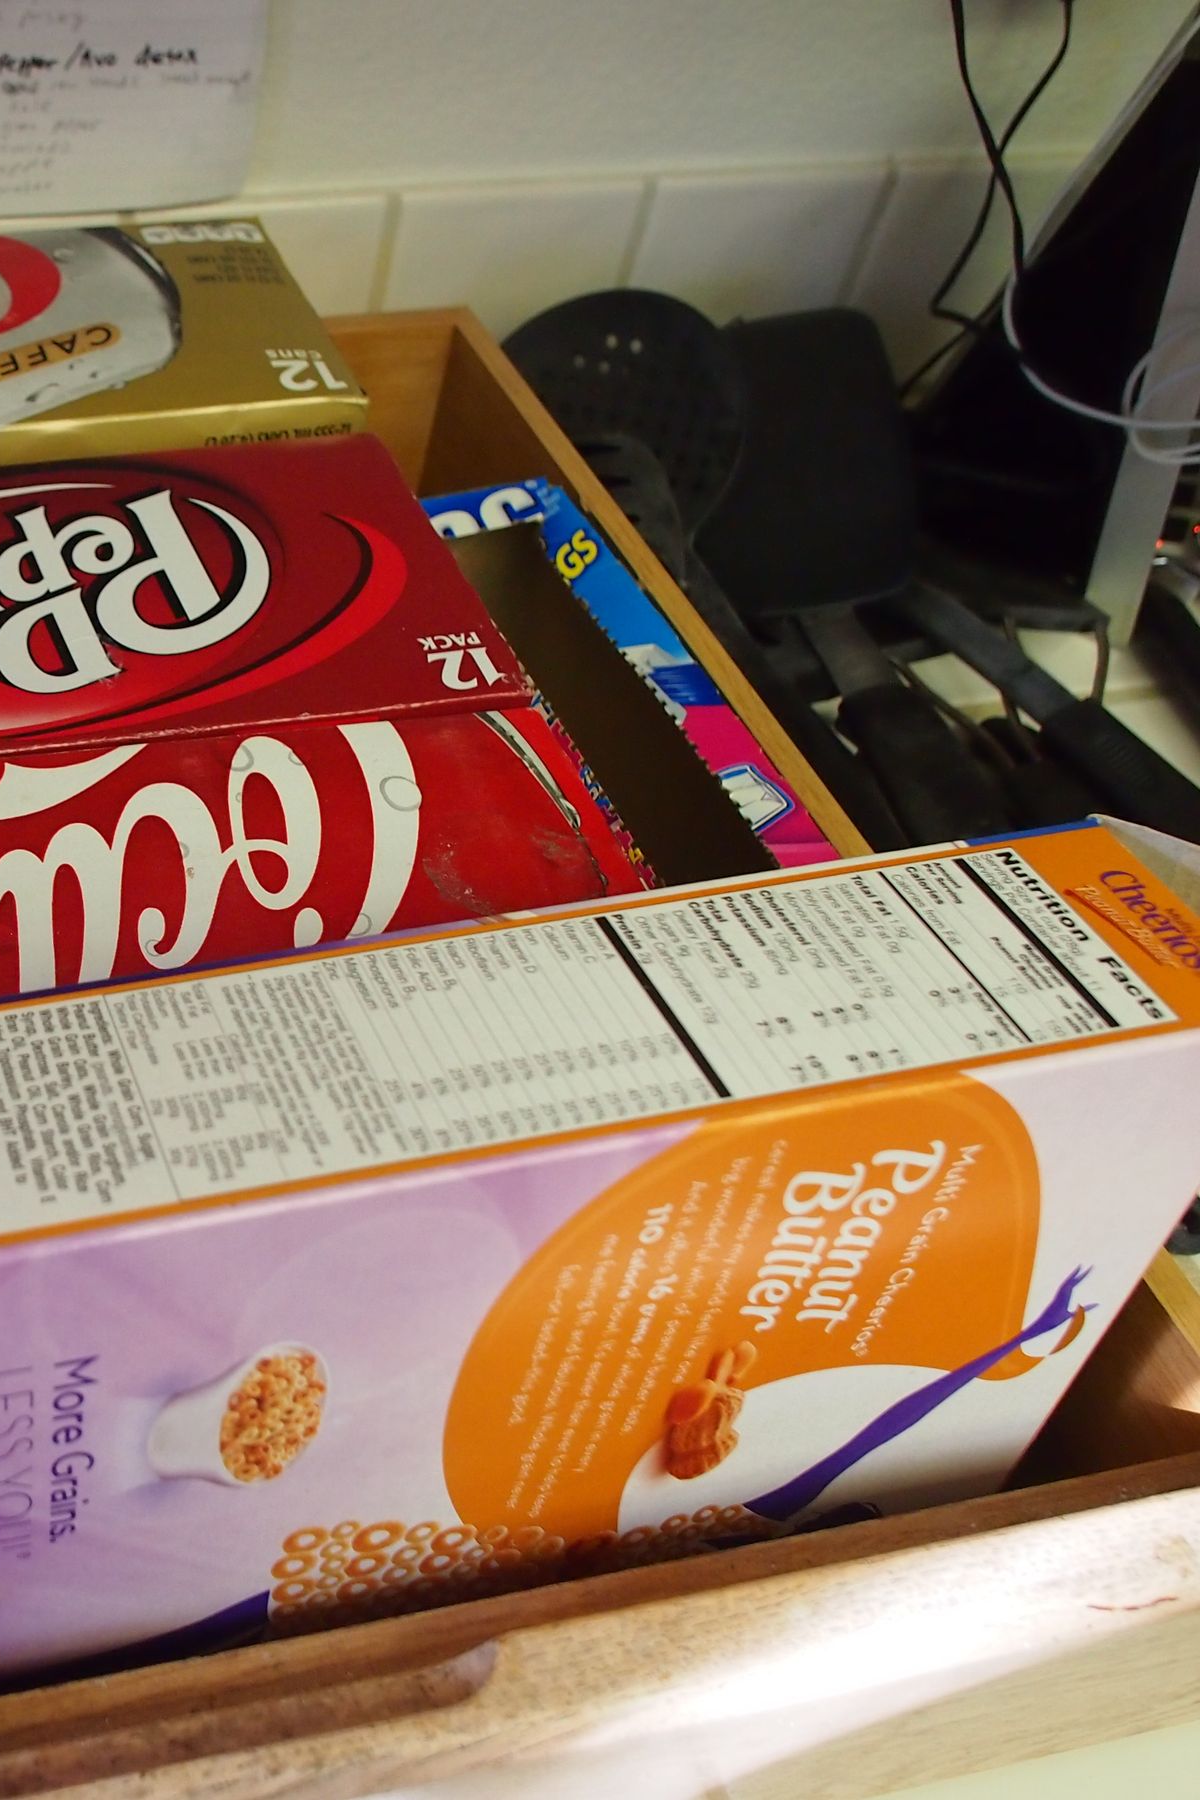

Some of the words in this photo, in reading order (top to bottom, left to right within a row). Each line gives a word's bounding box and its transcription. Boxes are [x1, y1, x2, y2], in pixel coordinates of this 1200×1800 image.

[269, 359, 349, 391] 12
[417, 630, 487, 652] PACK
[425, 645, 508, 691] 12
[849, 875, 876, 899] Total
[871, 900, 893, 917] Fat
[890, 874, 928, 907] Calories
[904, 866, 946, 904] Calories
[932, 862, 961, 888] Amount
[933, 877, 963, 904] Serving
[979, 854, 1015, 883] Serving
[1010, 885, 1035, 904] Size
[701, 898, 728, 923] Total
[721, 896, 766, 946] Potassium
[739, 893, 775, 928] Sodium
[758, 890, 810, 945] Cholesterol
[799, 889, 861, 957] Polyunsaturated
[817, 886, 843, 909] Trans
[837, 909, 857, 925] Fat
[835, 883, 877, 923] Saturated
[871, 924, 892, 940] Fat
[965, 856, 1006, 890] Servings
[1001, 891, 1023, 907] Per
[1017, 908, 1062, 949] Container
[520, 927, 541, 946] Iron
[541, 925, 573, 960] Calcium
[579, 919, 608, 950] Vitamin
[611, 914, 644, 949] Protein
[650, 913, 683, 943] Sugars
[668, 910, 702, 940] Dietary
[694, 941, 721, 965] Fiber
[686, 901, 745, 968] Carbohydrate
[782, 893, 848, 966] Monounsaturated
[996, 852, 1093, 941] Nutrition
[1096, 955, 1169, 1019] Facts
[442, 941, 469, 969] Niacin
[462, 938, 498, 981] Riboflavin
[482, 935, 512, 969] Thiamin
[634, 916, 660, 940] Other
[651, 942, 704, 1004] Carbohydrate
[933, 1142, 985, 1203] Multi
[636, 1201, 675, 1246] 110
[794, 1138, 948, 1335] Peanut
[899, 1205, 951, 1265] Grain
[738, 1161, 868, 1333] Butter
[646, 1273, 680, 1301] 16
[52, 1355, 97, 1445] More
